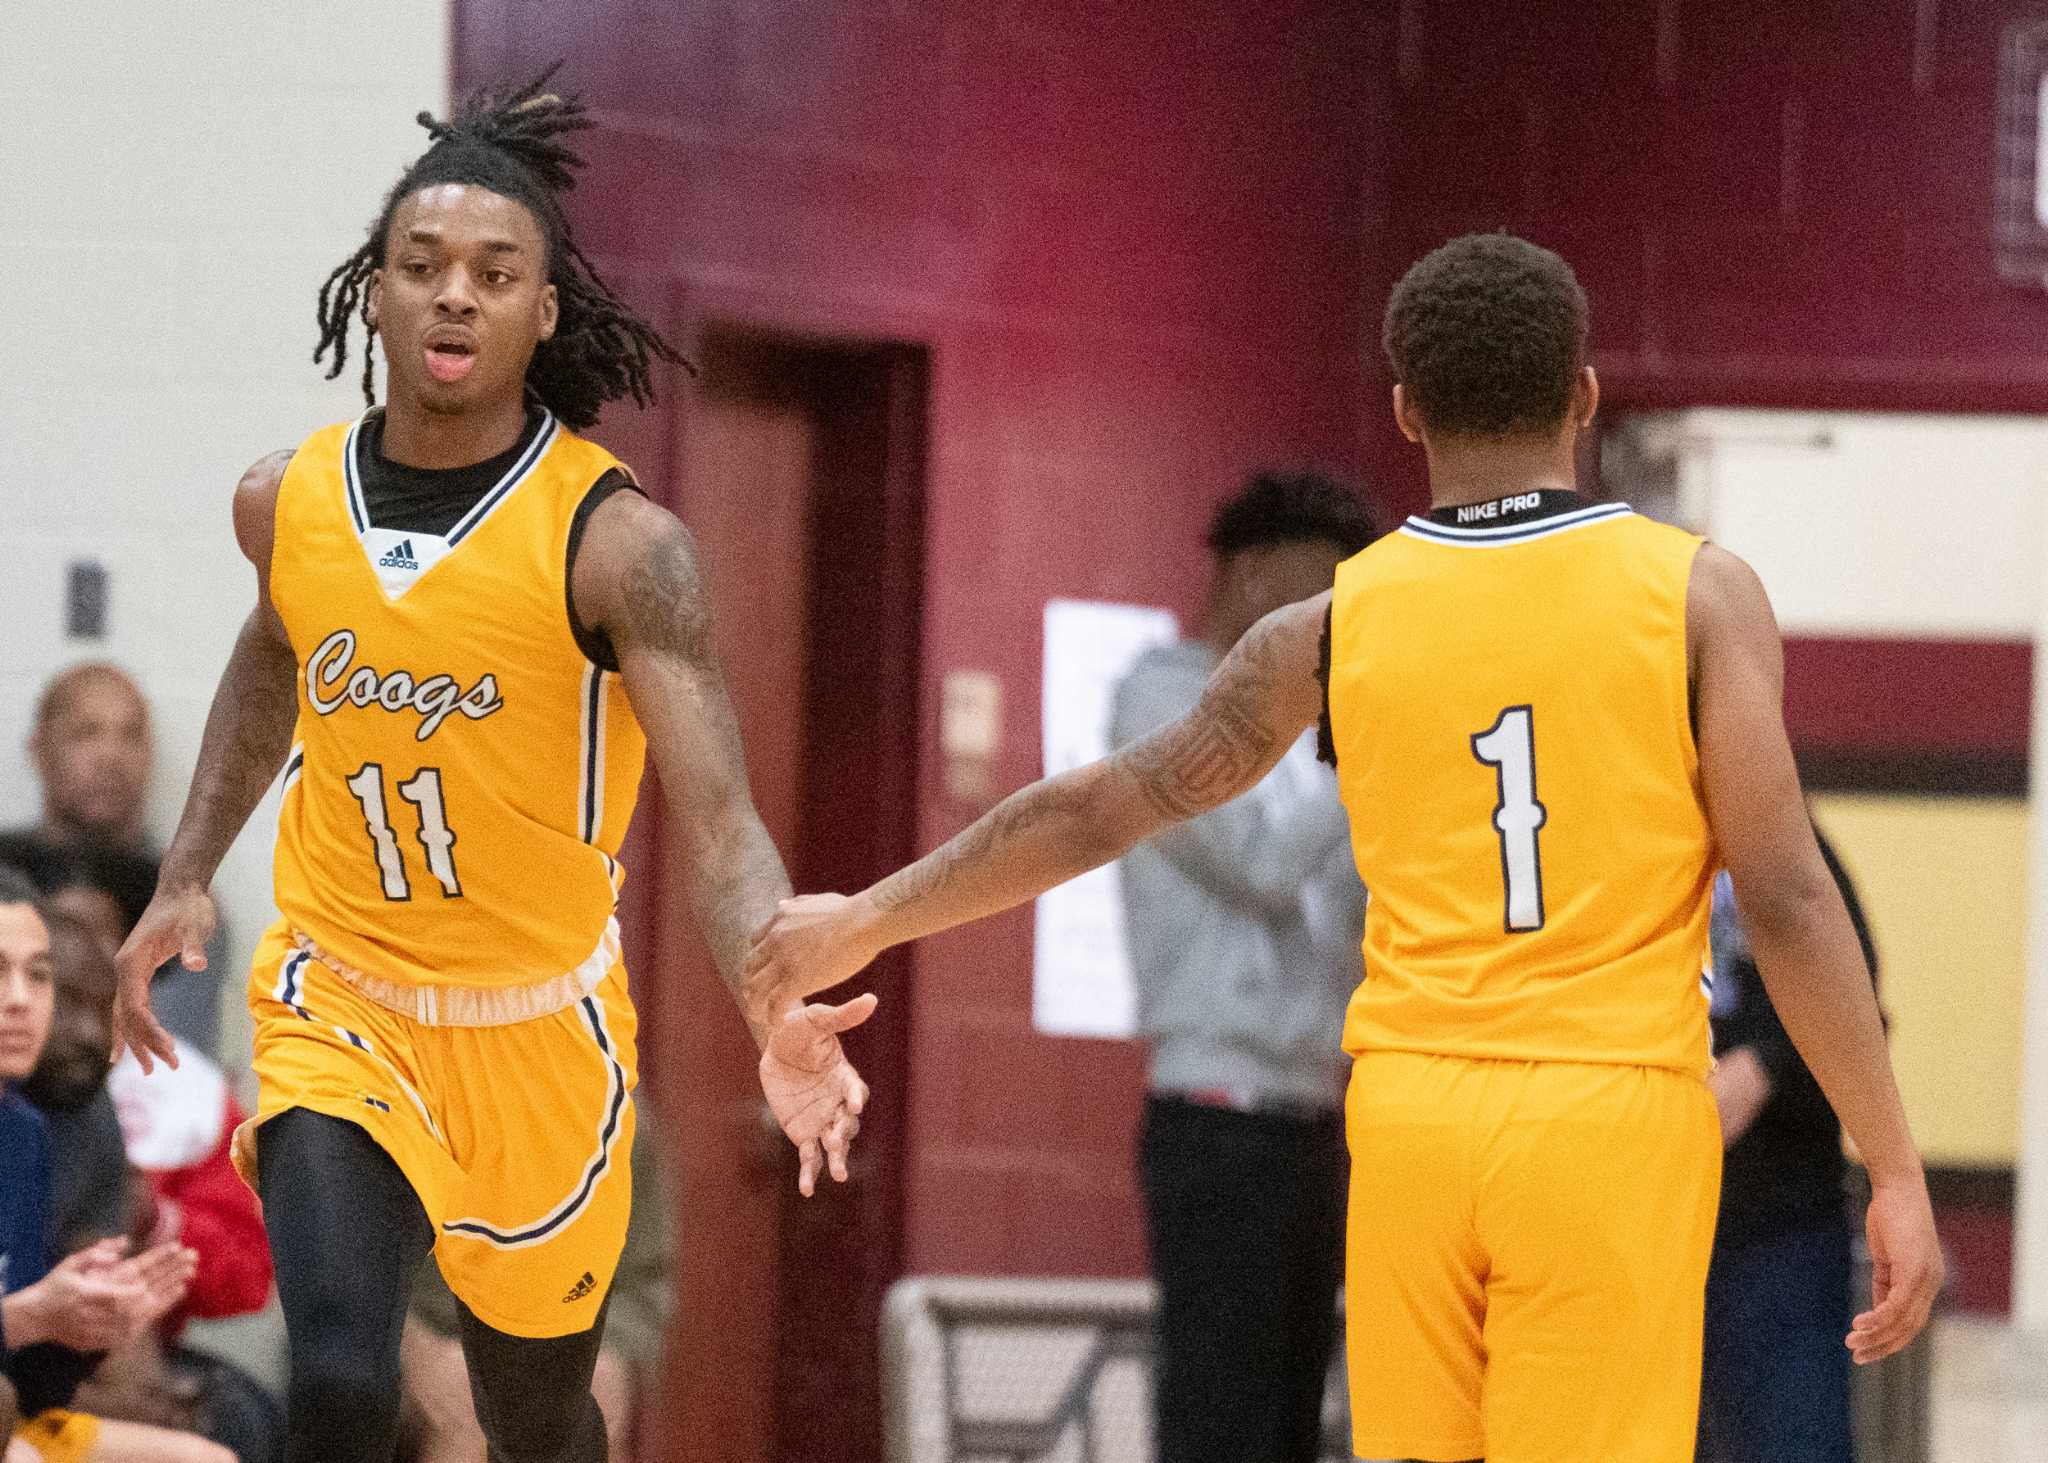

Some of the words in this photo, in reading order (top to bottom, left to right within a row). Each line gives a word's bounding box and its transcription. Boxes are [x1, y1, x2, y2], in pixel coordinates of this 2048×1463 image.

[379, 557, 419, 570] adidas
[1457, 501, 1499, 523] NIKE
[1501, 492, 1541, 515] PRO
[304, 628, 504, 742] Coogs
[345, 761, 464, 902] 11
[1469, 703, 1547, 934] 1
